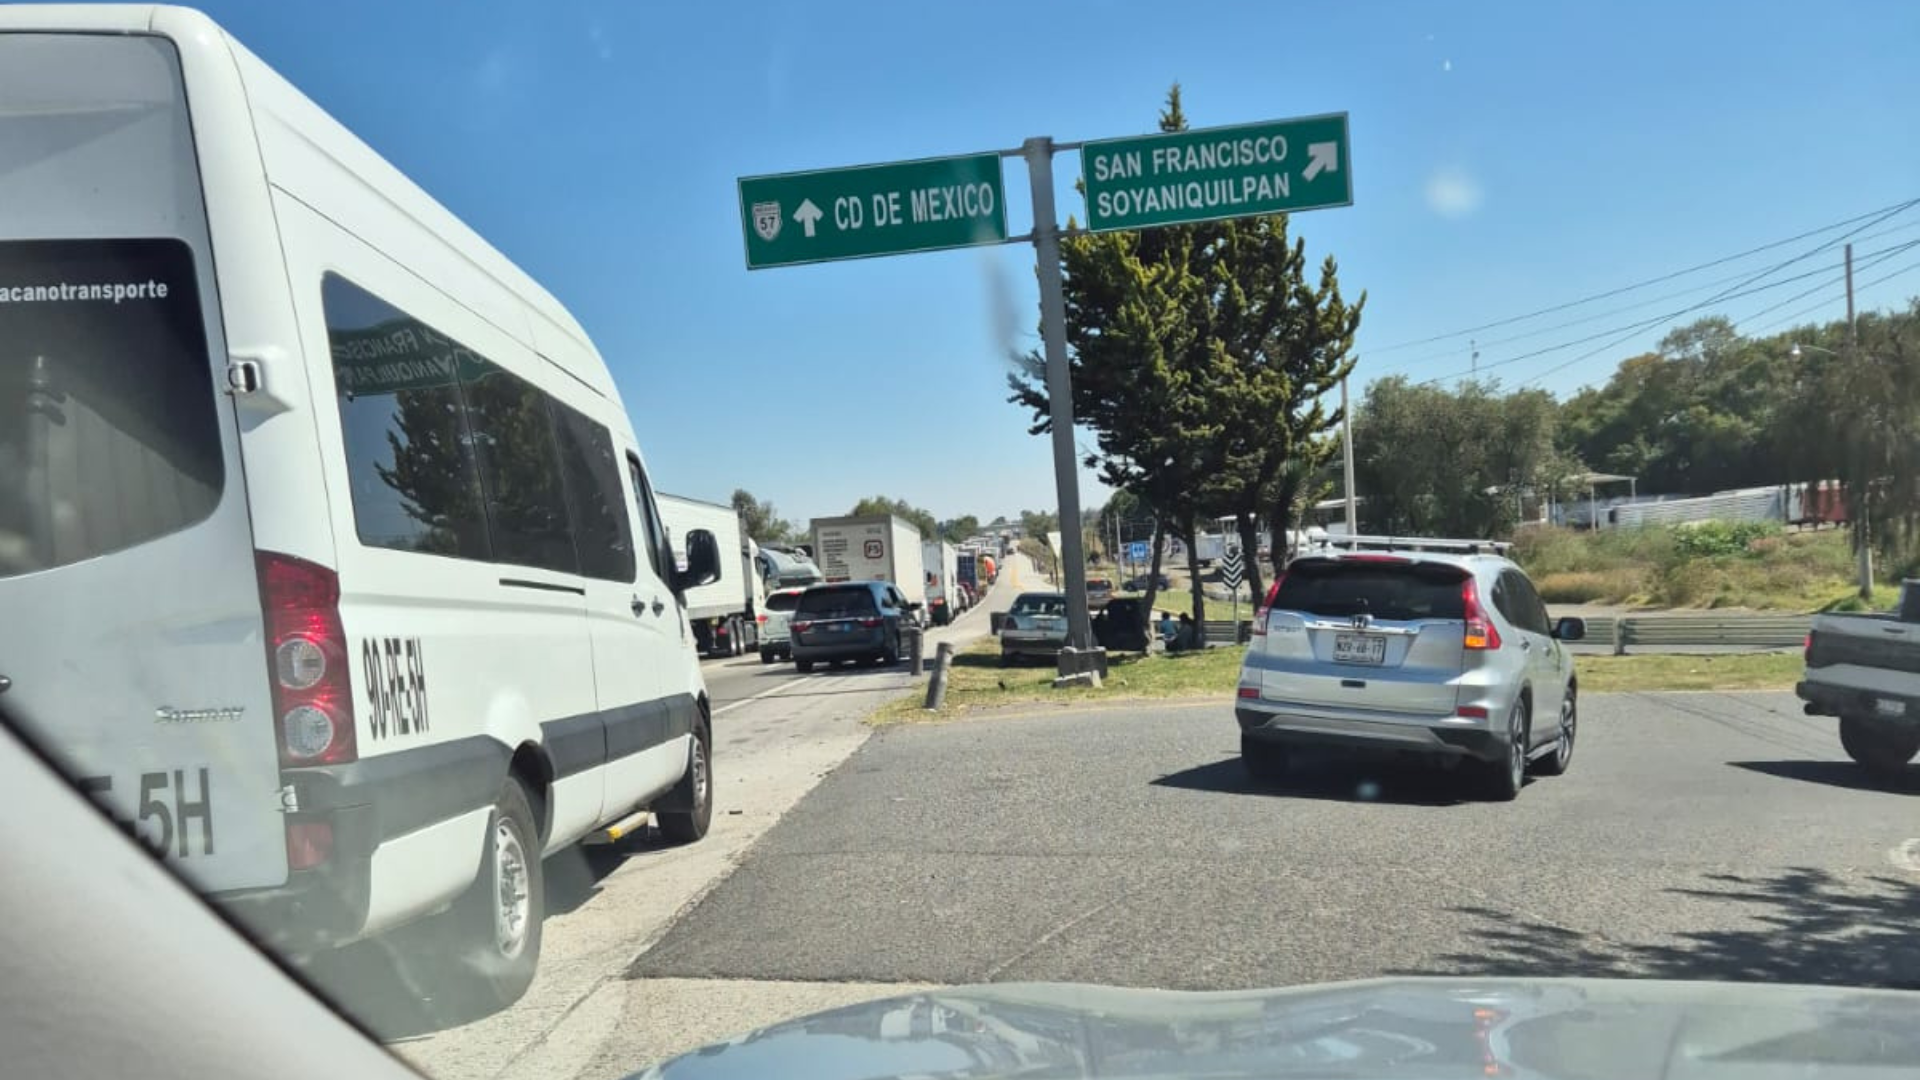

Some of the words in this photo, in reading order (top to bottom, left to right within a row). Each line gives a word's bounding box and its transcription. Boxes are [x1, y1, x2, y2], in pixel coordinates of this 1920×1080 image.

[1095, 151, 1142, 181] SAN
[1152, 135, 1288, 175] FRANCISCO
[834, 196, 863, 231] CD
[873, 192, 902, 227] DE
[911, 182, 994, 224] MEXICO
[1098, 172, 1290, 218] SOYANIQUILPAN
[759, 216, 775, 231] 57
[0, 279, 168, 304] acanotransporte
